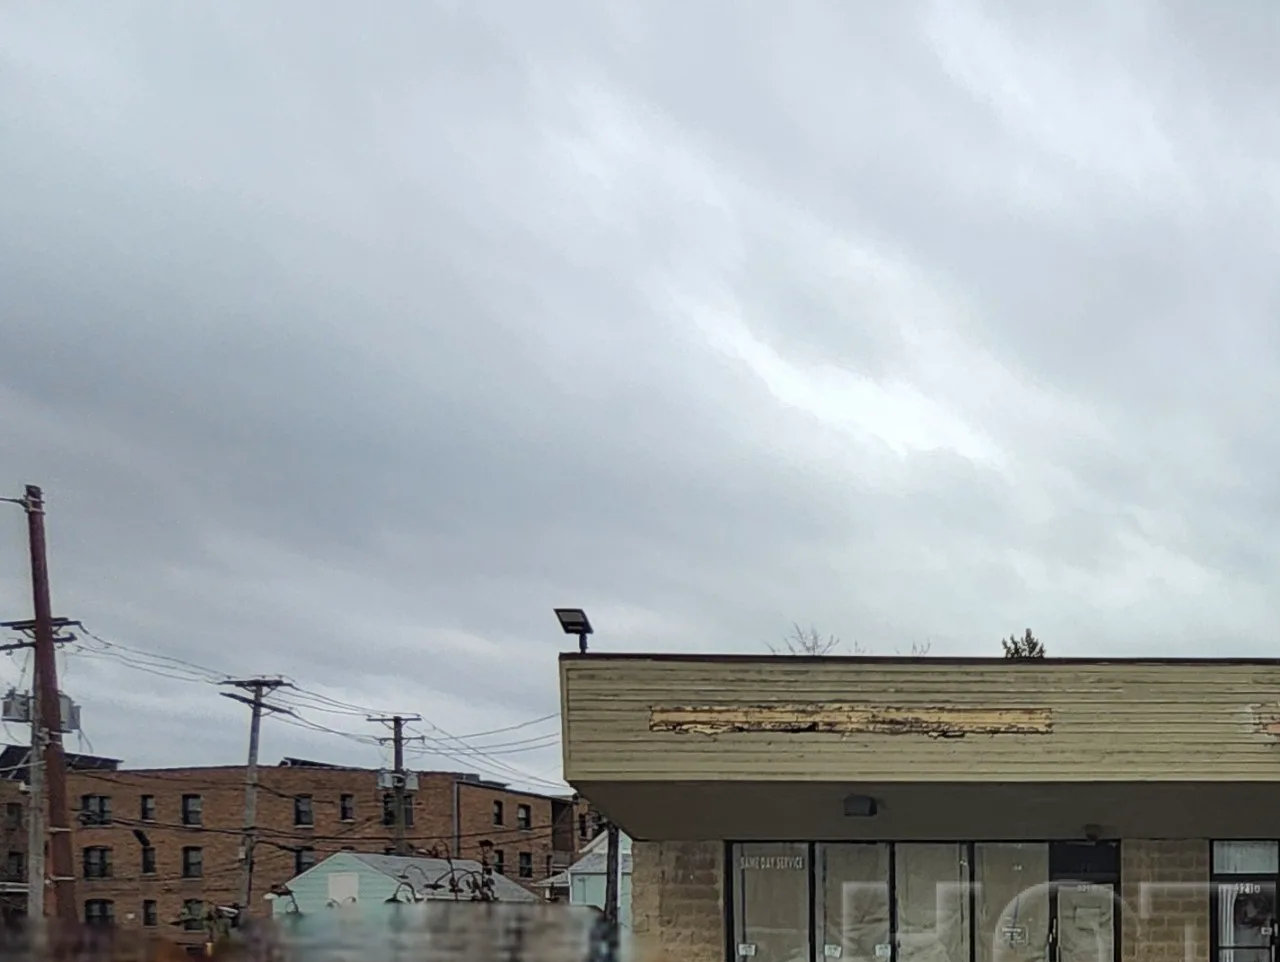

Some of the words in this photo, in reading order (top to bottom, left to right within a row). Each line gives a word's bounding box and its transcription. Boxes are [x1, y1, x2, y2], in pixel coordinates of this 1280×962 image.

[740, 855, 759, 869] SAME
[760, 855, 775, 869] DAY
[776, 855, 803, 869] SERVICE
